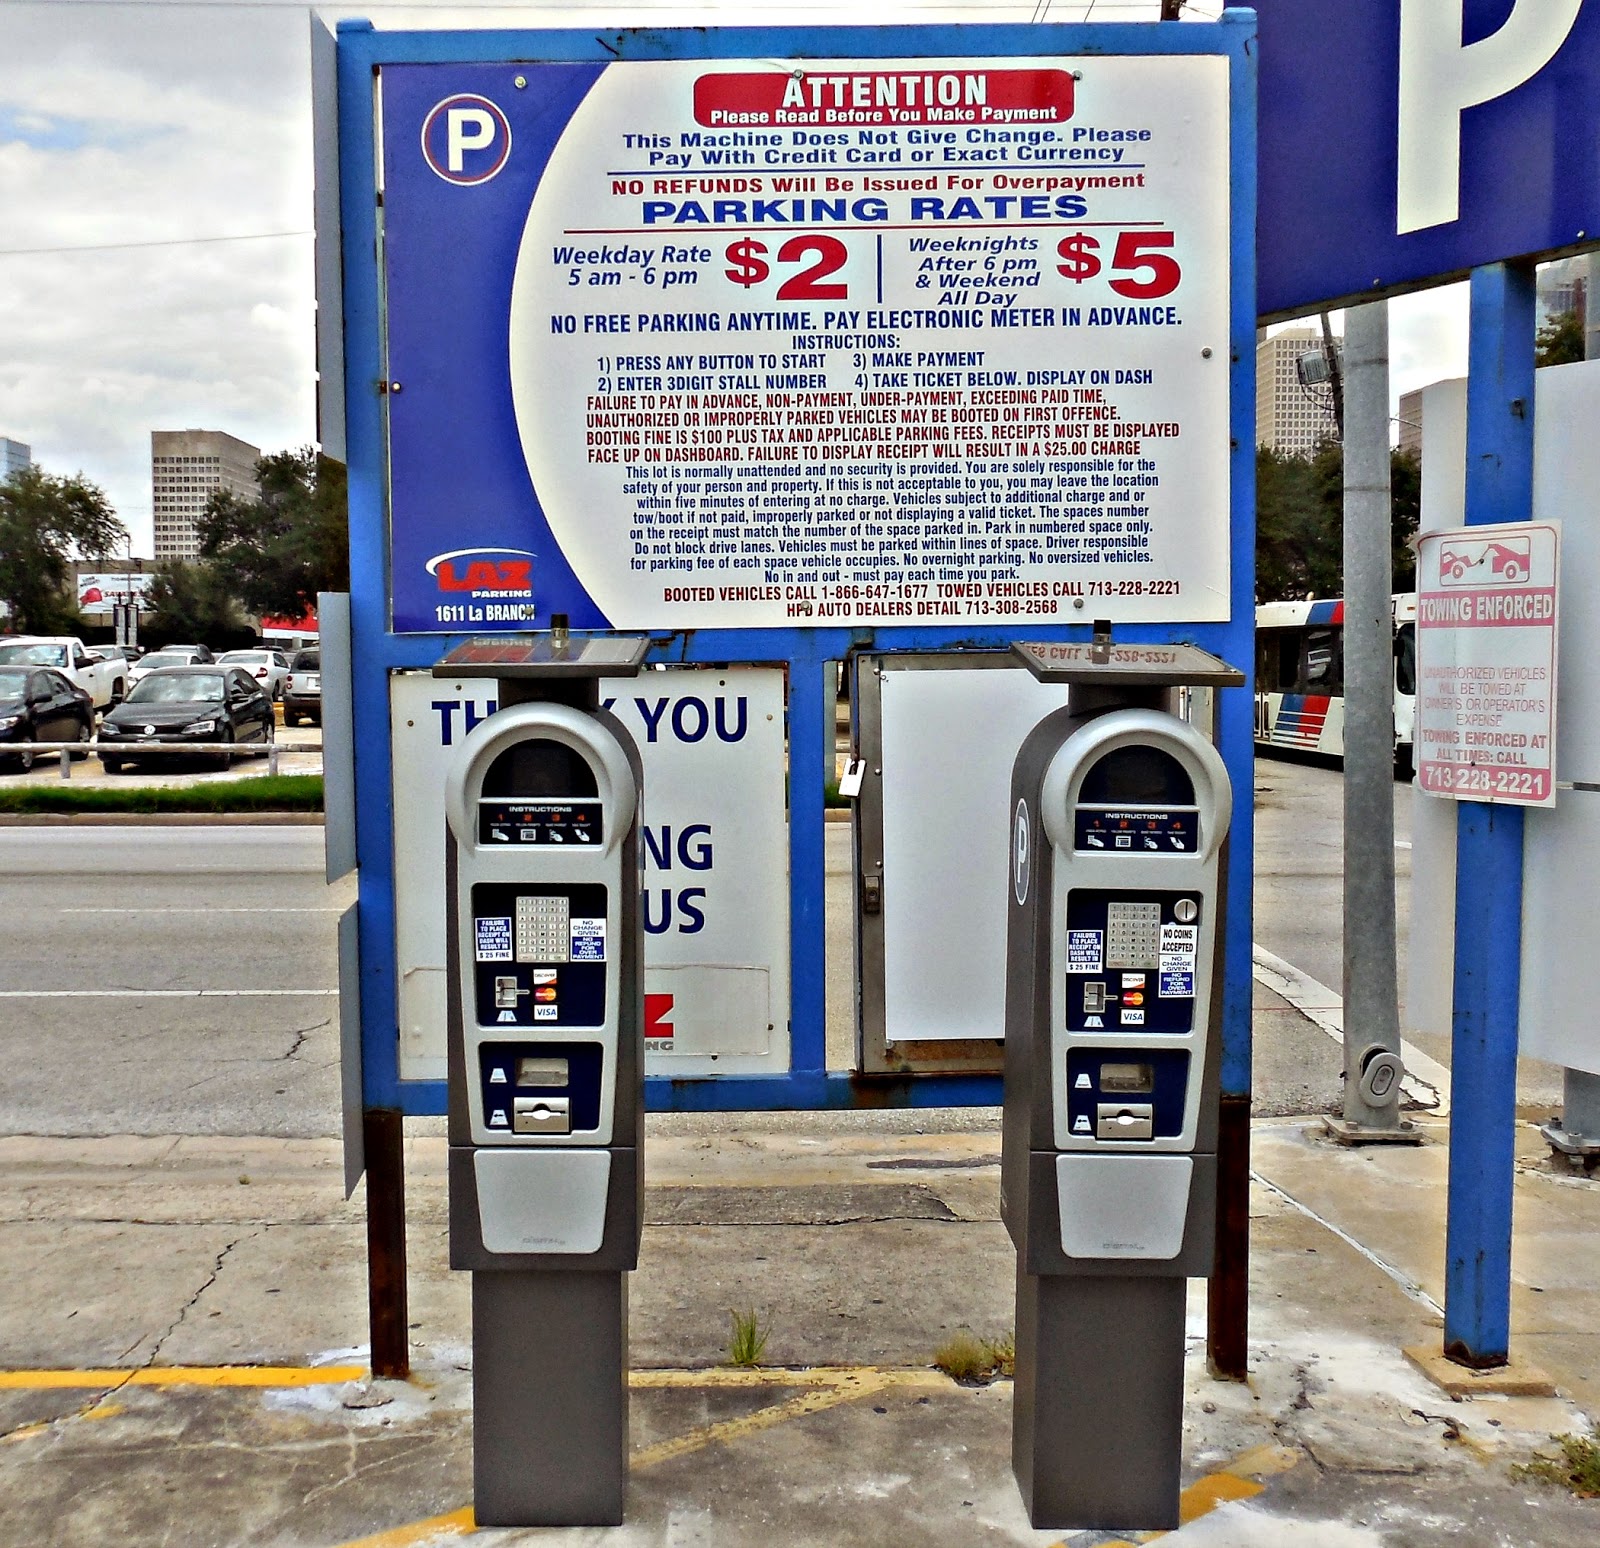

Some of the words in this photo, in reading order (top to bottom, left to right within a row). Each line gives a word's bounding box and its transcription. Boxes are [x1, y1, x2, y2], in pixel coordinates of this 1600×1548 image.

[782, 75, 987, 108] ATTENTION
[710, 110, 769, 126] Please
[775, 109, 820, 125] Read
[825, 109, 883, 124] Before
[889, 108, 921, 123] You
[927, 107, 975, 122] Make
[981, 106, 1057, 124] Payment
[447, 108, 496, 172] P
[621, 133, 672, 149] This
[680, 131, 783, 148] Machine
[792, 131, 850, 146] Does
[858, 130, 899, 145] Not
[906, 129, 957, 145] Give
[965, 128, 1064, 146] Change.
[1072, 127, 1152, 143] Please
[649, 151, 693, 169] Pay
[700, 149, 756, 165] With
[764, 148, 838, 164] Credit
[845, 147, 902, 163] Card
[910, 150, 936, 163] or
[943, 148, 1009, 162] Exact
[1017, 146, 1125, 166] Currency
[612, 179, 644, 196] NO
[653, 177, 763, 195] REFUNDS
[771, 177, 816, 193] Will
[825, 177, 854, 192] Be
[863, 175, 938, 192] Issued
[947, 175, 984, 190] For
[992, 173, 1145, 193] Overpayment
[642, 197, 889, 225] PARKING
[910, 194, 1088, 221] RATES
[909, 235, 1039, 255] Weeknights
[552, 245, 654, 271] Weekday
[661, 245, 712, 263] Rate
[724, 234, 848, 301] $2
[917, 255, 978, 272] After
[983, 255, 997, 271] 6
[1003, 258, 1037, 277] pm
[1055, 230, 1182, 300] $5
[568, 268, 582, 286] 5
[587, 271, 622, 286] am
[644, 268, 657, 286] 6
[661, 270, 698, 290] pm
[915, 273, 932, 289] &
[940, 272, 1041, 288] Weekend
[936, 290, 969, 306] All
[974, 290, 1019, 309] Day
[550, 314, 577, 334] NO
[583, 314, 631, 334] FREE
[637, 312, 721, 333] PARKING
[726, 311, 817, 332] ANYTIME.
[823, 310, 861, 330] PAY
[866, 309, 984, 330] ELECTRONIC
[990, 306, 1056, 328] METER
[1061, 307, 1081, 327] IN
[1087, 306, 1183, 327] ADVANCE.
[792, 333, 901, 350] INSTRUCTIONS:
[596, 356, 611, 375] 1)
[615, 355, 662, 371] PRESS
[665, 355, 695, 371] ANY
[698, 354, 754, 370] BUTTON
[758, 354, 777, 370] TO
[781, 353, 827, 369] START
[852, 352, 867, 371] 3)
[872, 352, 913, 368] MAKE
[917, 351, 986, 367] PAYMENT
[597, 376, 612, 395] 2)
[617, 376, 663, 392] ENTER
[666, 375, 715, 391] 3DIGIT
[718, 374, 761, 391] STALL
[765, 373, 827, 390] NUMBER
[854, 373, 869, 392] 4)
[872, 372, 909, 388] TAKE
[912, 372, 963, 388] TICKET
[967, 371, 1022, 387] BELOW.
[1026, 369, 1087, 386] DISPLAY
[1090, 369, 1110, 385] ON
[1114, 369, 1153, 385] DASH
[587, 395, 637, 411] FAILURE
[639, 394, 656, 410] TO
[659, 394, 683, 410] PAY
[686, 394, 699, 410] IN
[702, 393, 762, 411] ADVANCE,
[765, 392, 857, 410] NON-PAYMENT,
[860, 388, 967, 408] UNDER-PAYMENT,
[970, 389, 1038, 406] EXCEEDING
[1041, 389, 1070, 404] PAID
[1072, 388, 1107, 406] TIME,
[629, 557, 647, 571] for
[649, 556, 693, 573] parking
[696, 556, 715, 569] fee
[718, 555, 730, 569] of
[733, 555, 761, 569] each
[763, 557, 798, 573] space
[800, 553, 842, 568] vehicle
[845, 551, 900, 572] occupies.
[903, 552, 919, 566] No
[921, 551, 976, 568] overnight
[978, 551, 1026, 570] parking.
[1028, 550, 1044, 564] No
[1046, 550, 1101, 564] oversized
[1103, 549, 1154, 563] vehicles.
[437, 561, 533, 592] LAZ
[471, 590, 532, 599] PARKING
[663, 587, 715, 602] BOOTED
[718, 585, 782, 602] VEHICLES
[785, 585, 818, 601] CALL
[821, 583, 929, 600] 1-866-647-1677
[936, 583, 983, 599] TOWED
[986, 580, 1049, 597] VEHICLES
[1052, 581, 1085, 597] CALL
[1088, 580, 1180, 596] 713-228-2221
[435, 604, 465, 622] 1611
[468, 604, 484, 621] La
[817, 601, 851, 617] AUTO
[855, 601, 913, 616] DEALERS
[916, 600, 962, 616] DETAIL
[965, 599, 1058, 615] 713-308-2568
[1420, 597, 1473, 622] TOWING
[1476, 594, 1553, 620] ENFORCED
[1498, 667, 1546, 681] VEHICLES
[1460, 683, 1476, 695] BE
[1478, 683, 1512, 696] TOWED
[1513, 683, 1526, 696] AT
[1466, 698, 1482, 711] OR
[1484, 698, 1546, 713] OPERATOR'S
[634, 696, 748, 744] YOU
[1456, 713, 1503, 727] EXPENSE
[1423, 729, 1460, 745] TOWING
[1465, 731, 1527, 748] ENFORCED
[1531, 734, 1547, 749] AT
[1436, 748, 1452, 760] ALL
[1455, 749, 1494, 763] TIMES:
[1496, 751, 1527, 765] CALL
[1163, 929, 1173, 939] NO
[1174, 929, 1193, 940] COINS
[1161, 942, 1193, 952] ACCEPTED
[537, 1008, 556, 1016] VISA
[1123, 1013, 1143, 1021] VISA
